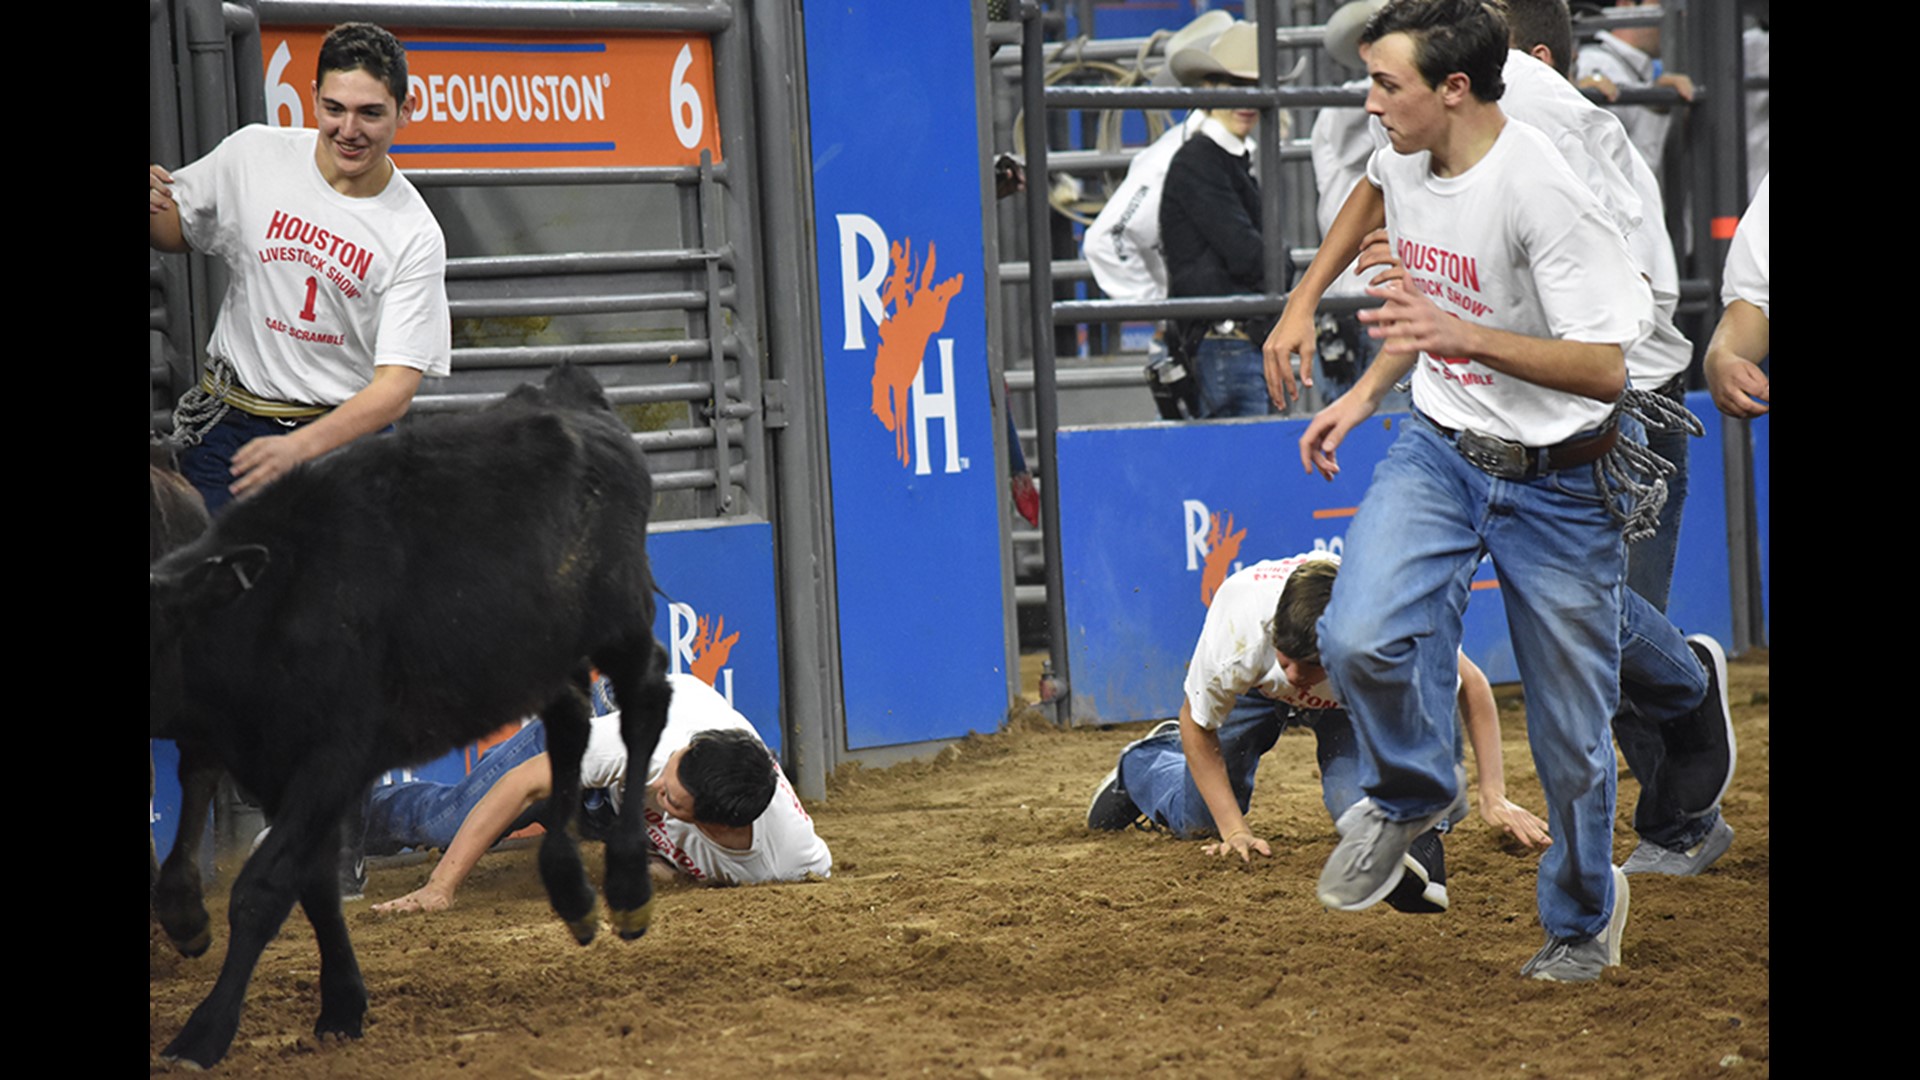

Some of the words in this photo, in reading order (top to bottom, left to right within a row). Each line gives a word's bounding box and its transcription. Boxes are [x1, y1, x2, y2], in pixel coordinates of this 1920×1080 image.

[264, 40, 304, 128] 6
[670, 44, 703, 149] 6
[259, 247, 327, 272] LIVESTOCK
[265, 210, 374, 281] HOUSTON
[299, 275, 318, 322] 1
